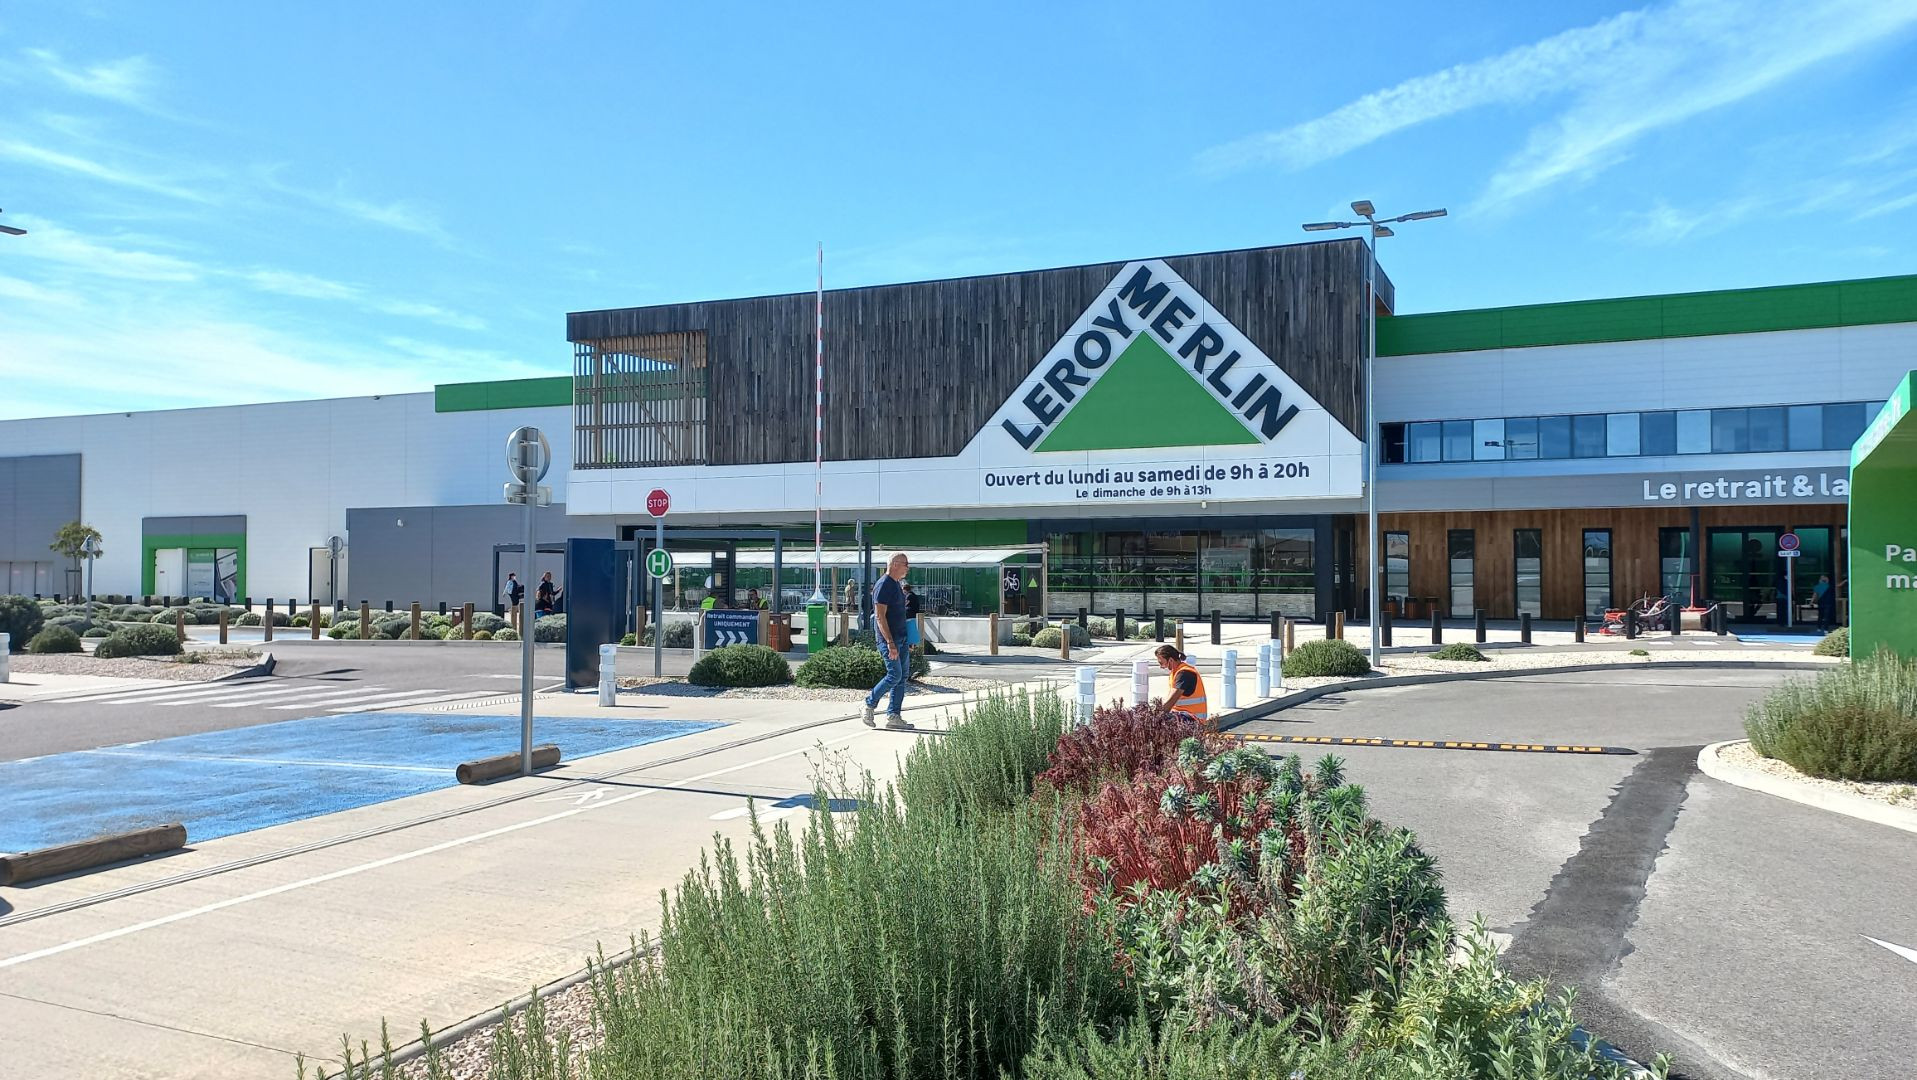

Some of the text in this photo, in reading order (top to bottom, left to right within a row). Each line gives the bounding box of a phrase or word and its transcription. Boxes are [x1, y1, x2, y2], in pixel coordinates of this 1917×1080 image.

[1001, 265, 1300, 450] LEROY MERLIN
[985, 461, 1310, 486] Ouvert du lundi au samedi de 9h à 20h
[1076, 484, 1212, 498] Le dimanche de 9h à 13h
[1643, 473, 1850, 500] Le retrait & la
[648, 499, 668, 508] STOP
[651, 554, 666, 572] H
